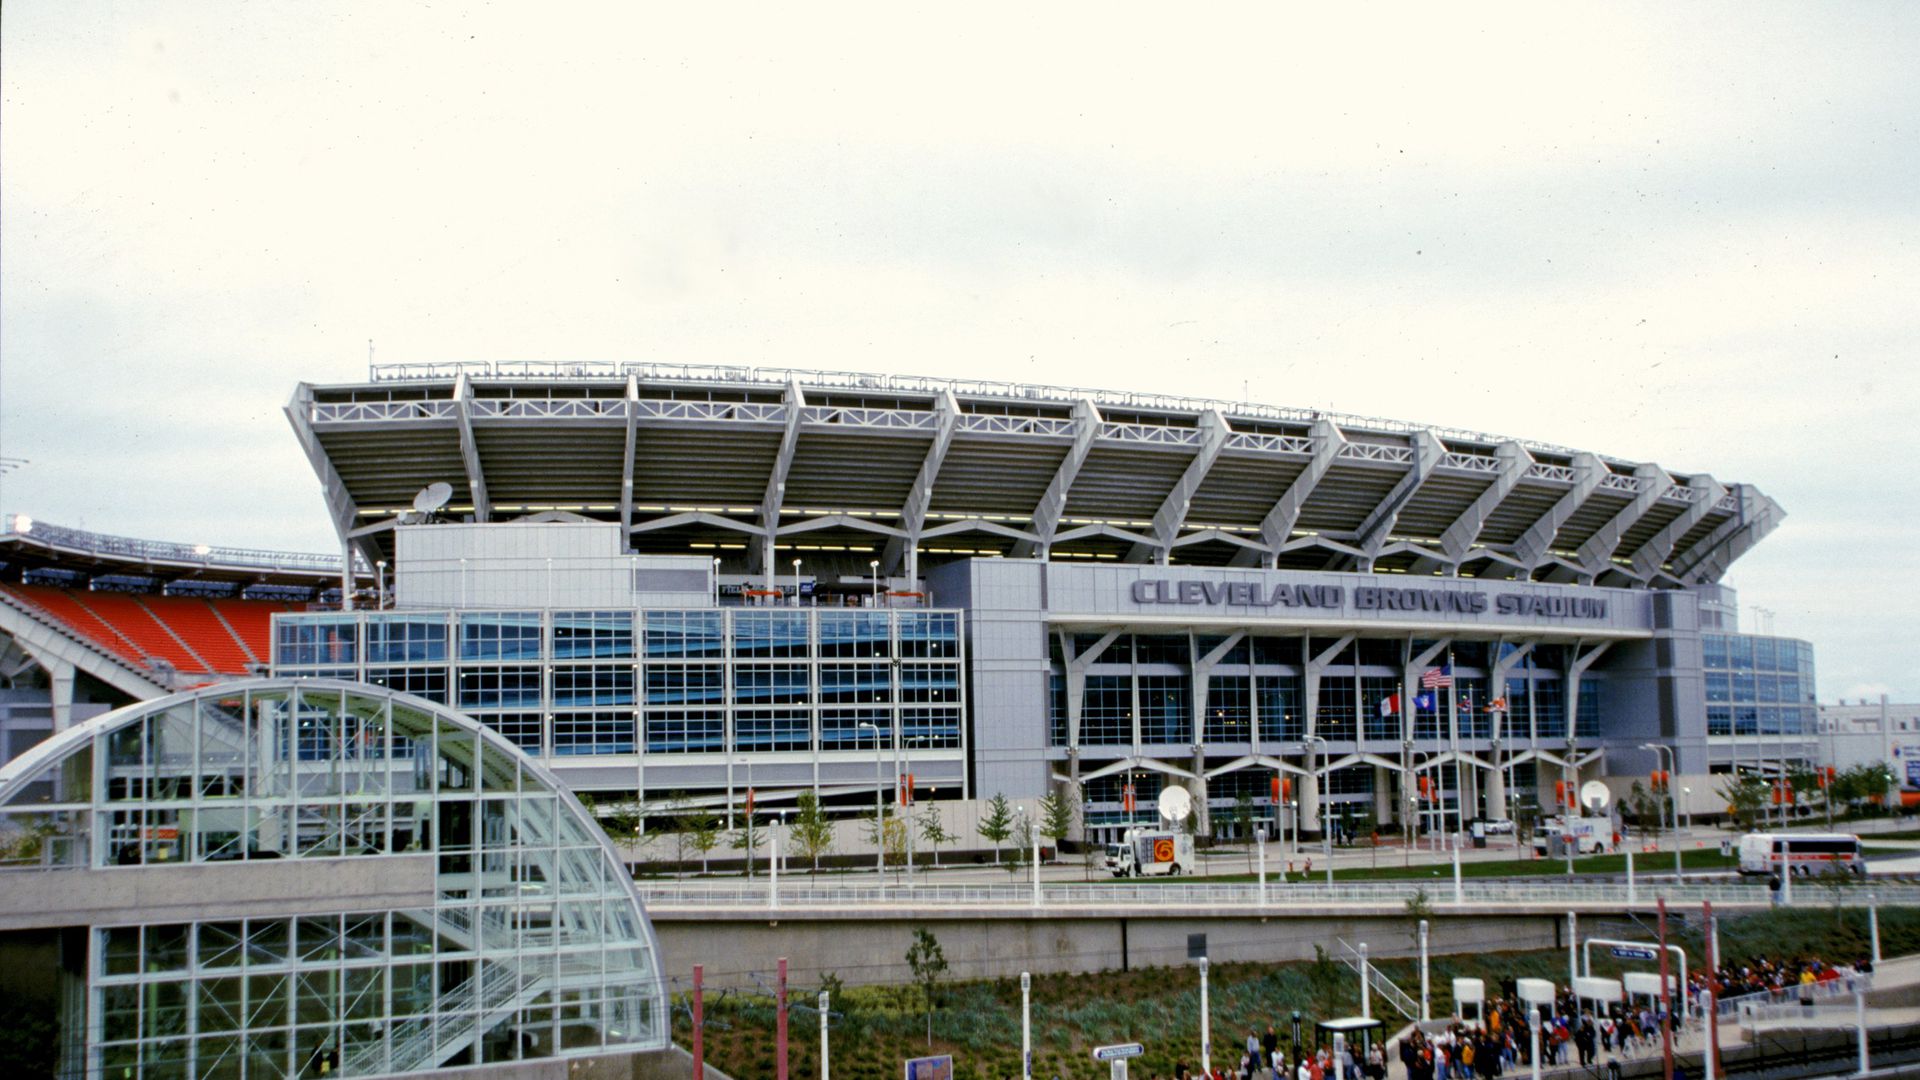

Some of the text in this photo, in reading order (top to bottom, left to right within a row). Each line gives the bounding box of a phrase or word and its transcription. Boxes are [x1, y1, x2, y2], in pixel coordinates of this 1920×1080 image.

[1132, 580, 1608, 619] CLEVELAND BROWNS STADIUM
